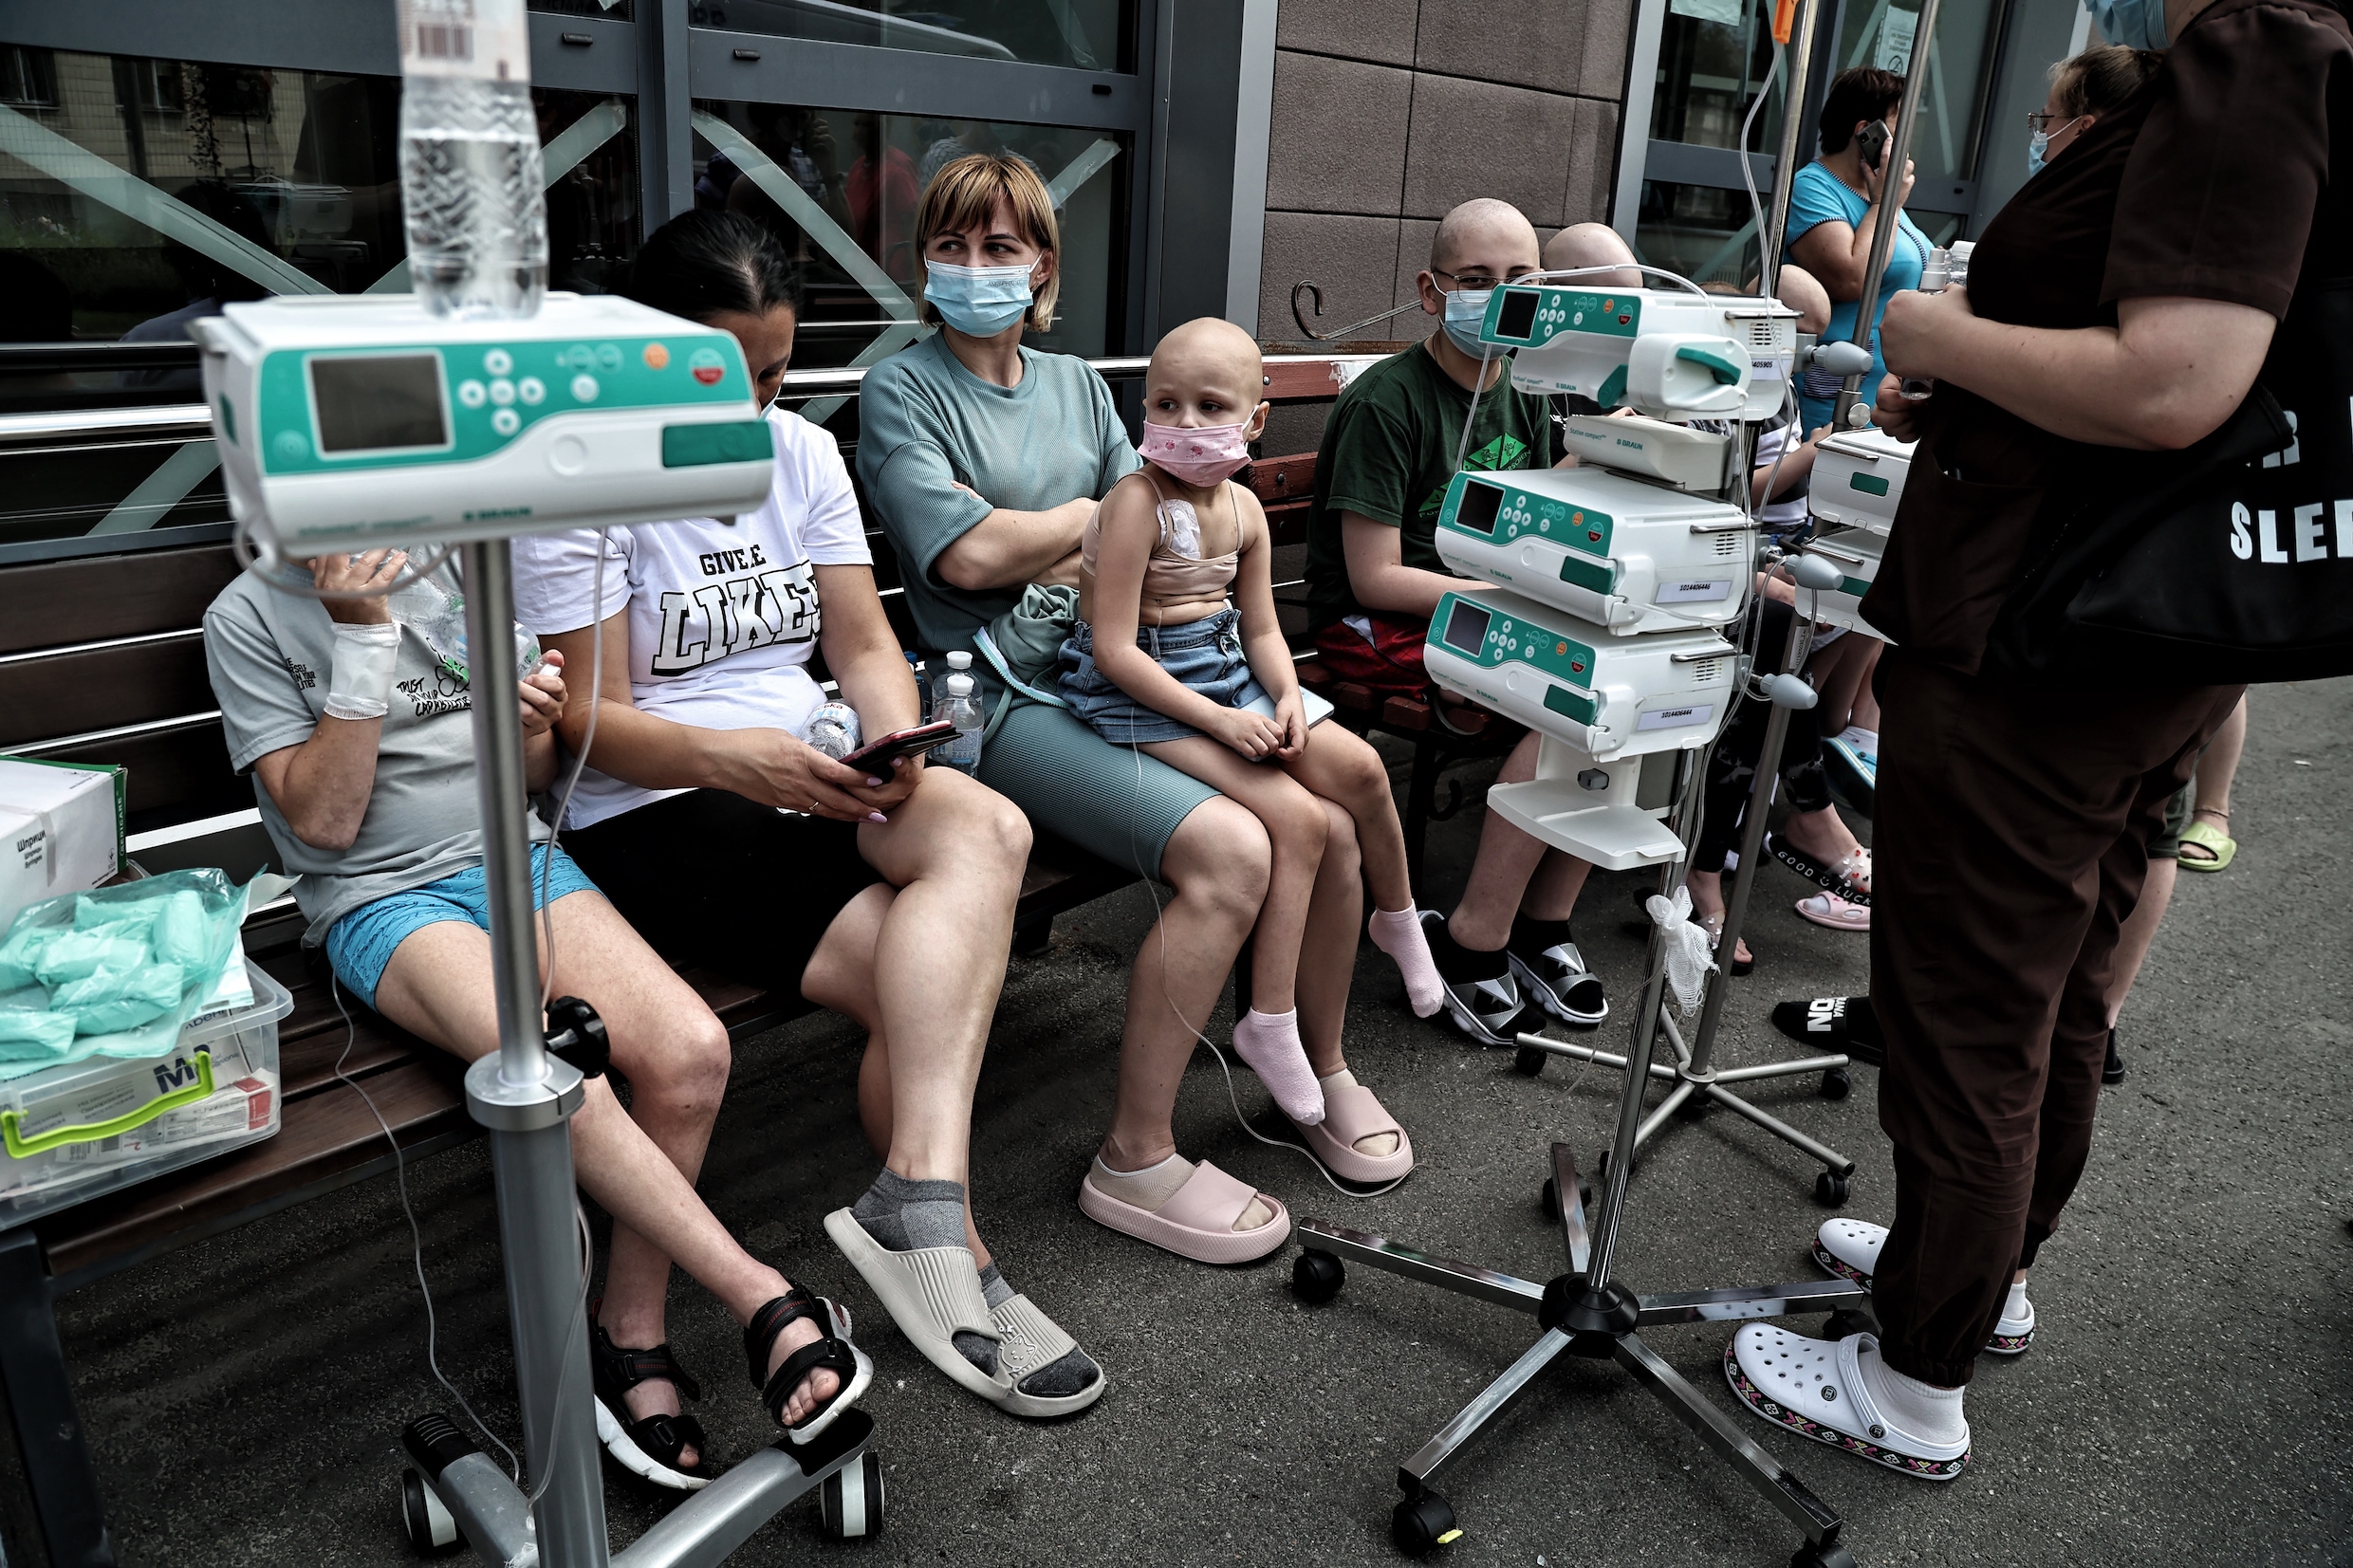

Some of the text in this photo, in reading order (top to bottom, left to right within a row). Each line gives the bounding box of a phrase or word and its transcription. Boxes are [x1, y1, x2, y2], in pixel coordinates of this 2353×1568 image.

[1621, 439, 1643, 451] BRAUN
[698, 548, 749, 576] GIVE
[396, 676, 425, 693] TRUST
[17, 829, 46, 853] Шприци
[1777, 851, 1814, 877] GOOD
